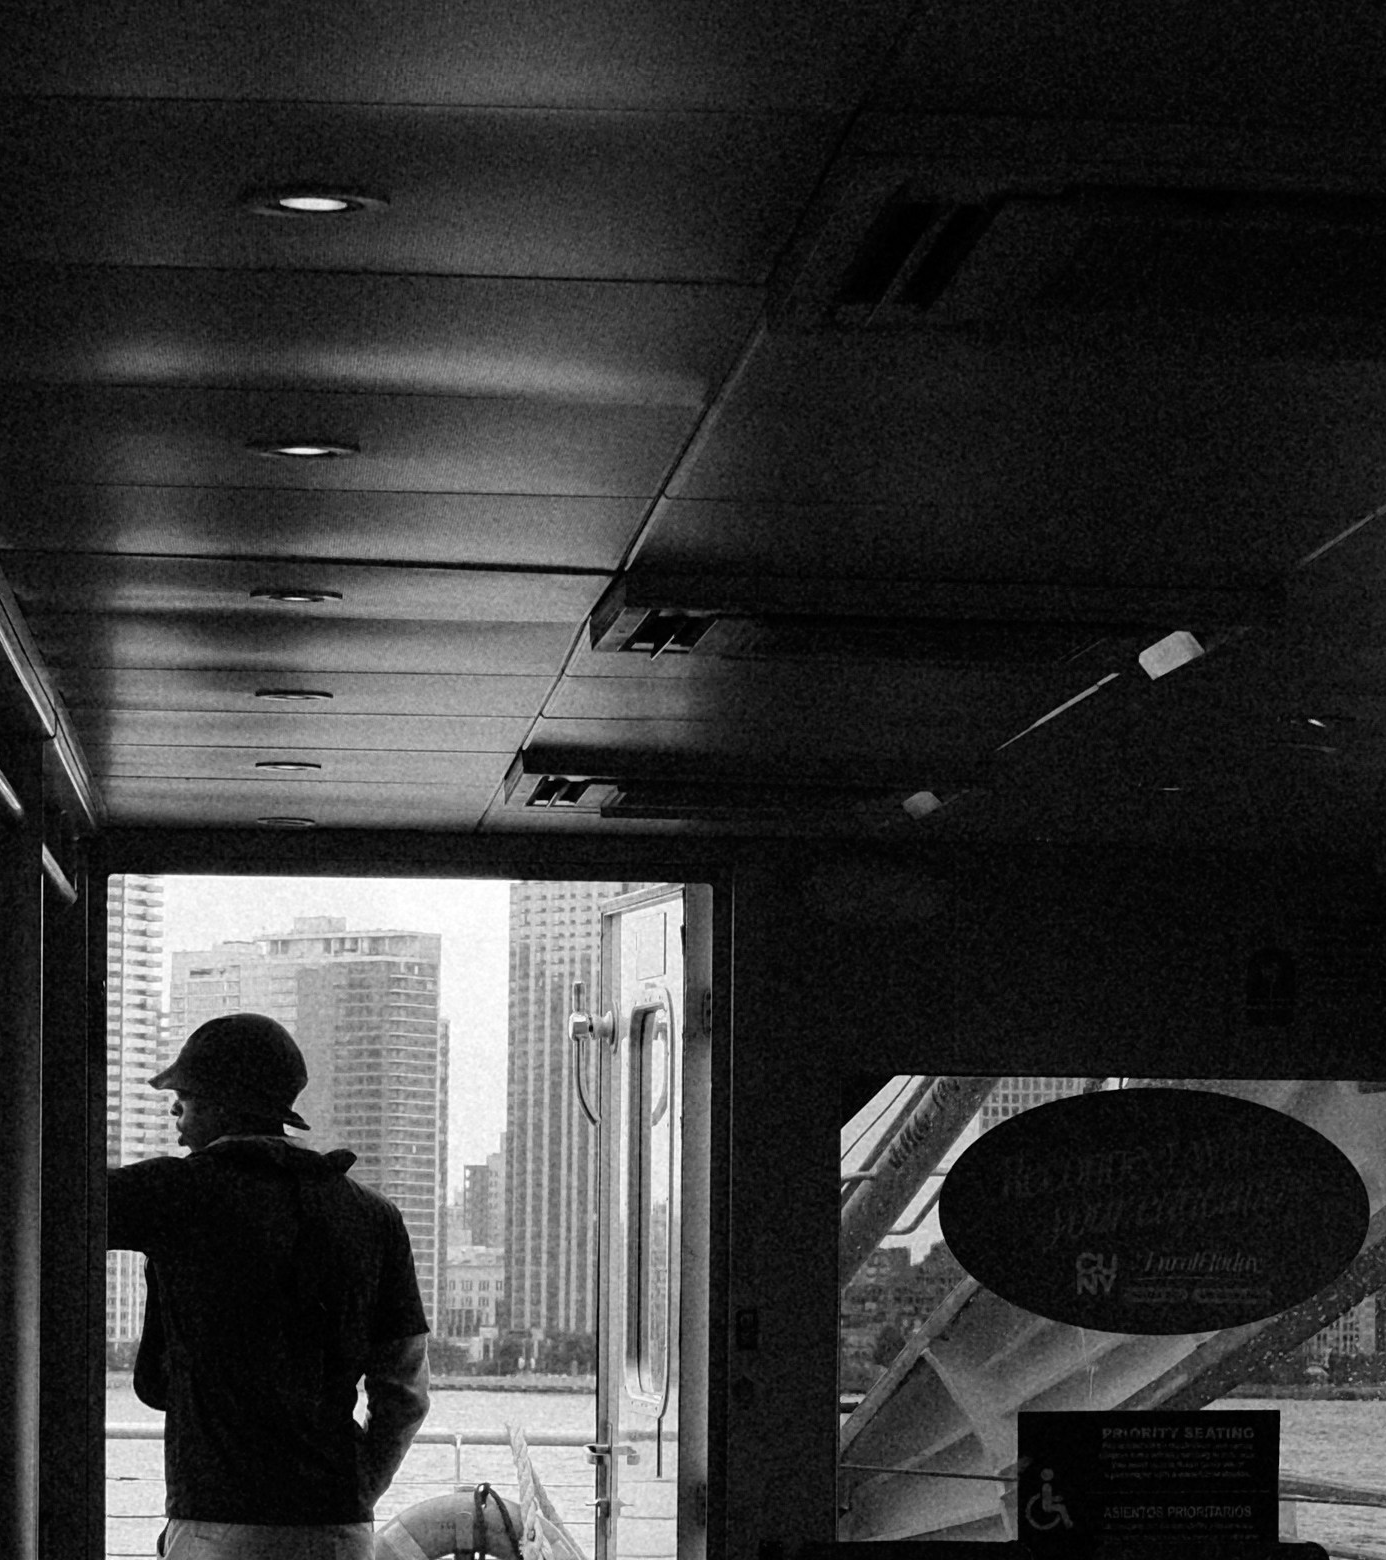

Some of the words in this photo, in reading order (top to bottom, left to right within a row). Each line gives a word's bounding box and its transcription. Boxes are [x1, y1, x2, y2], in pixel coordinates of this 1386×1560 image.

[1100, 1426, 1179, 1441] PRIORITY
[1183, 1426, 1256, 1441] SEATING
[1102, 1505, 1165, 1520] ASIENTOS
